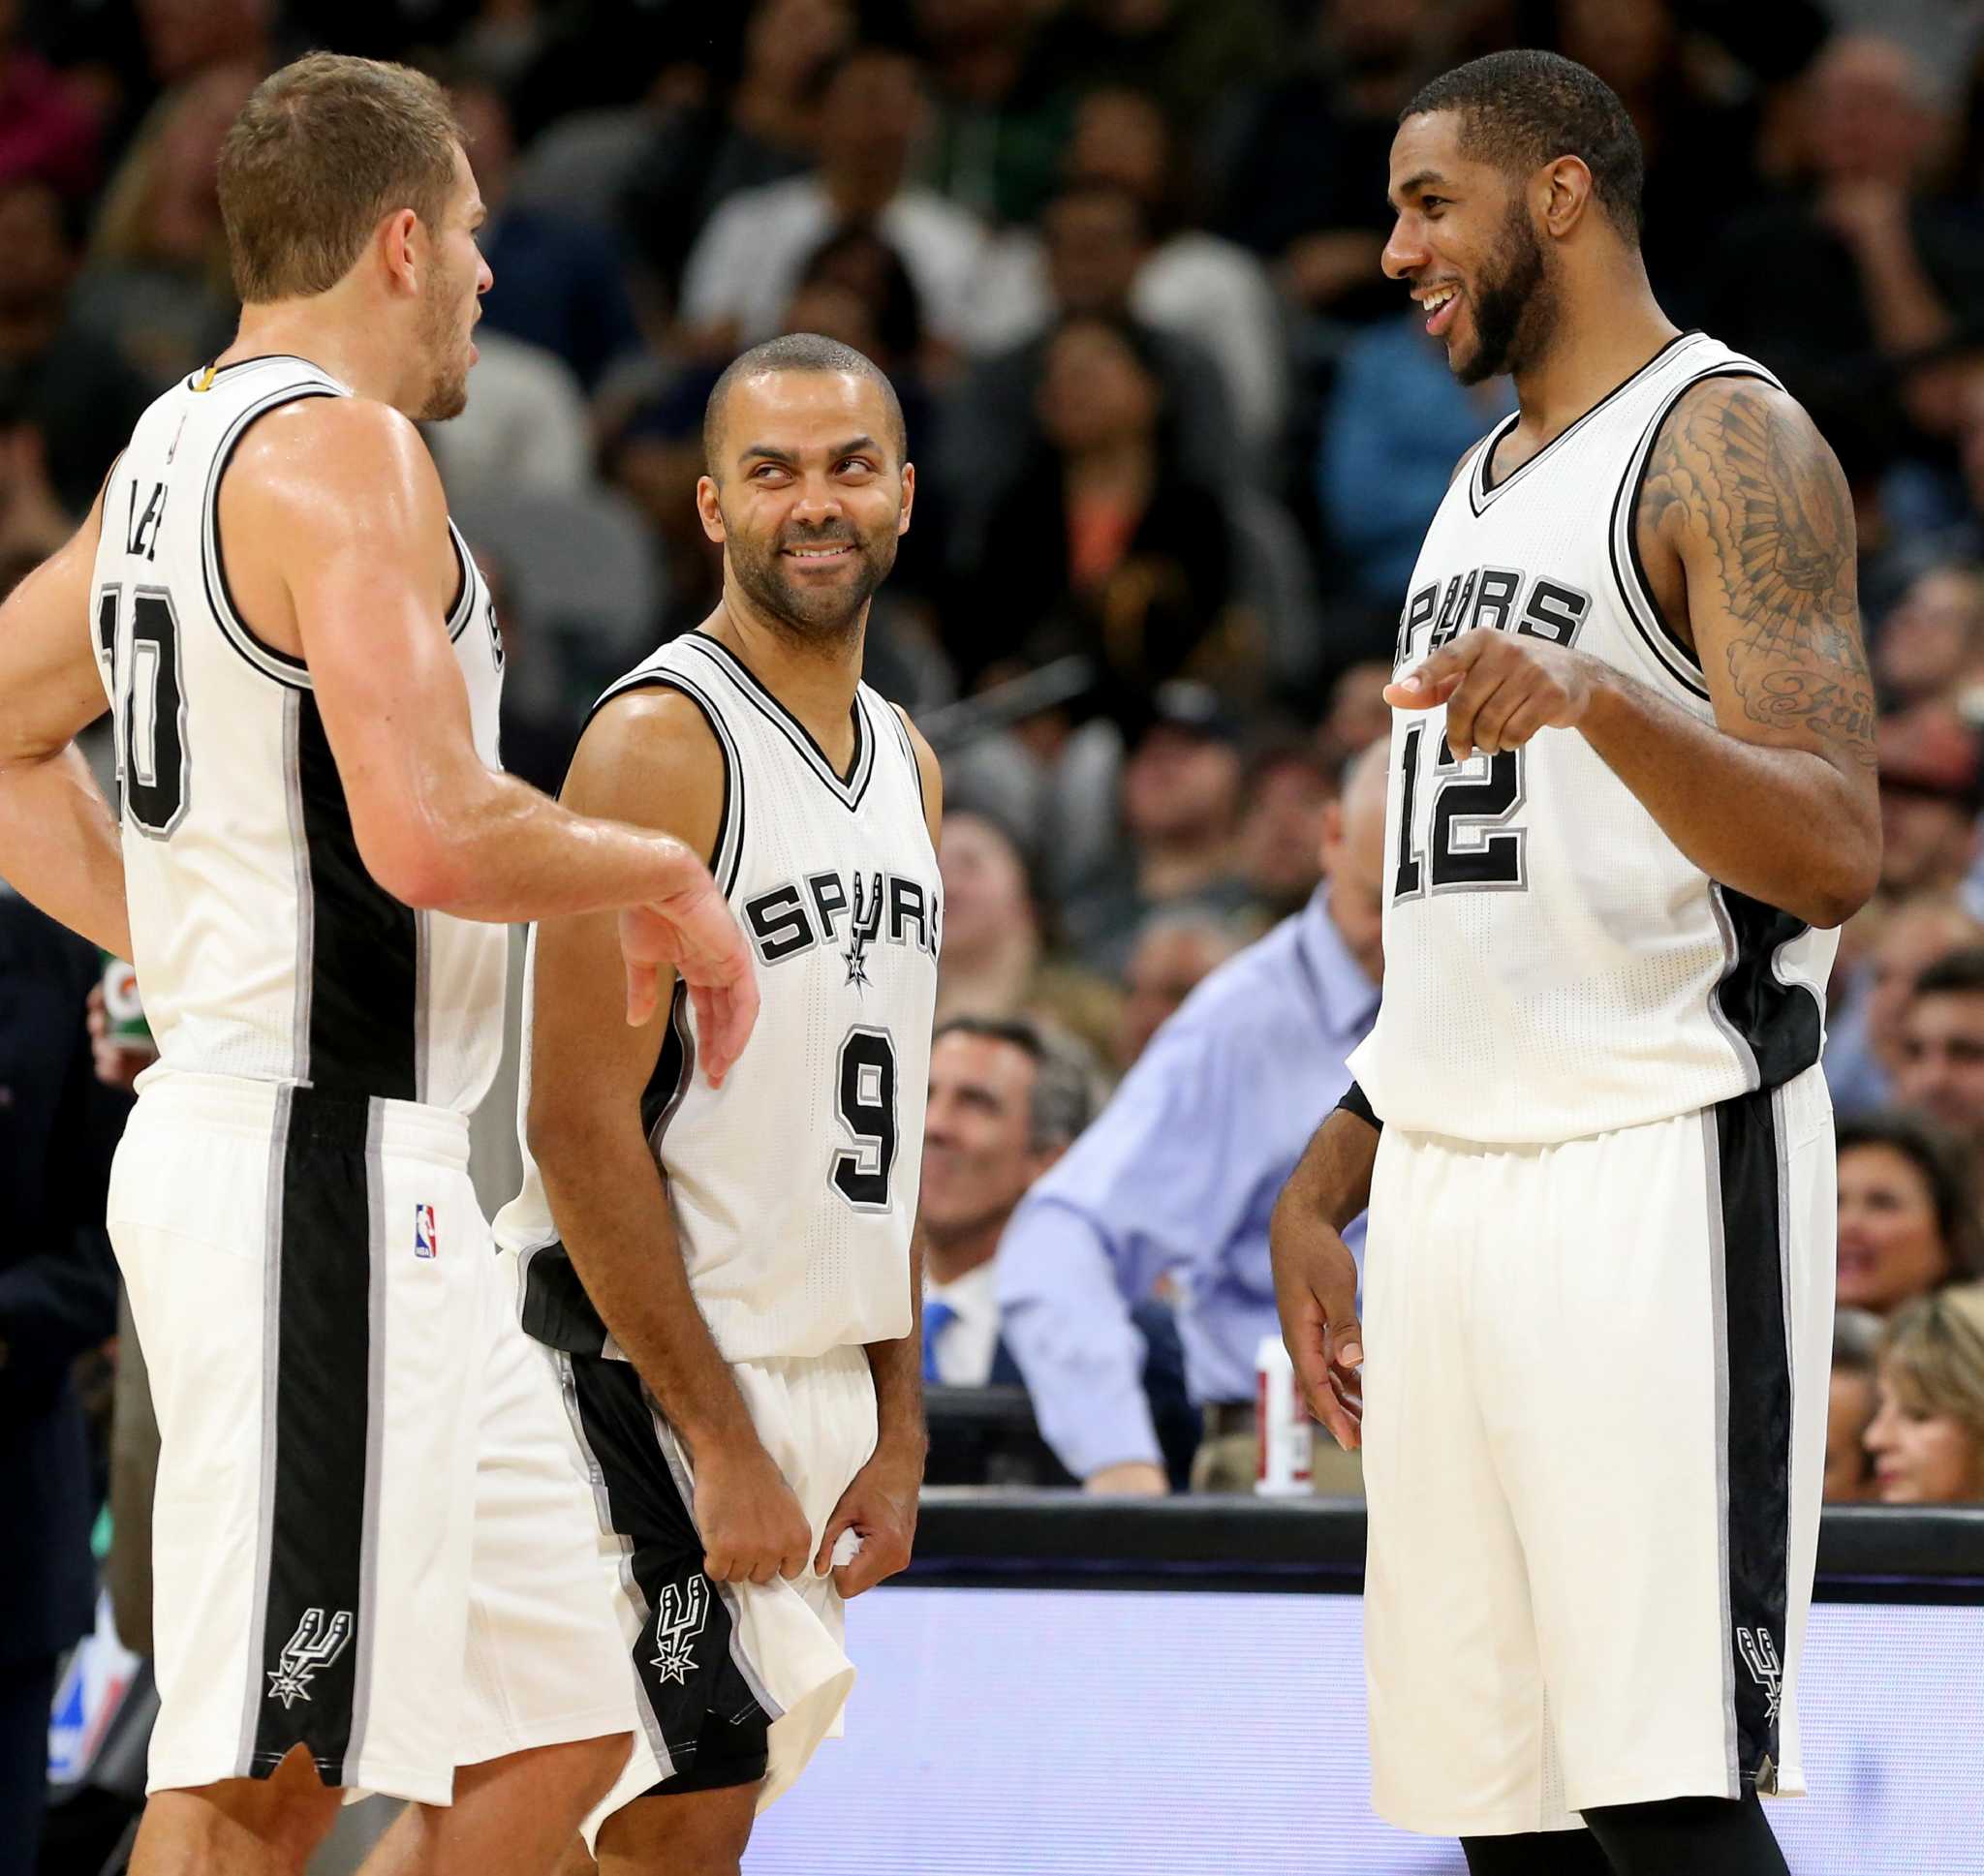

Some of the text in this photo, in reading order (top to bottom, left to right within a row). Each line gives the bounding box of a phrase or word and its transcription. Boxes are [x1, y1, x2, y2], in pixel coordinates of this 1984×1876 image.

[126, 477, 169, 562] LEE
[1393, 564, 1593, 670] PURS
[97, 582, 192, 844] 10
[1393, 719, 1529, 908] 12
[826, 1023, 900, 1215] 9
